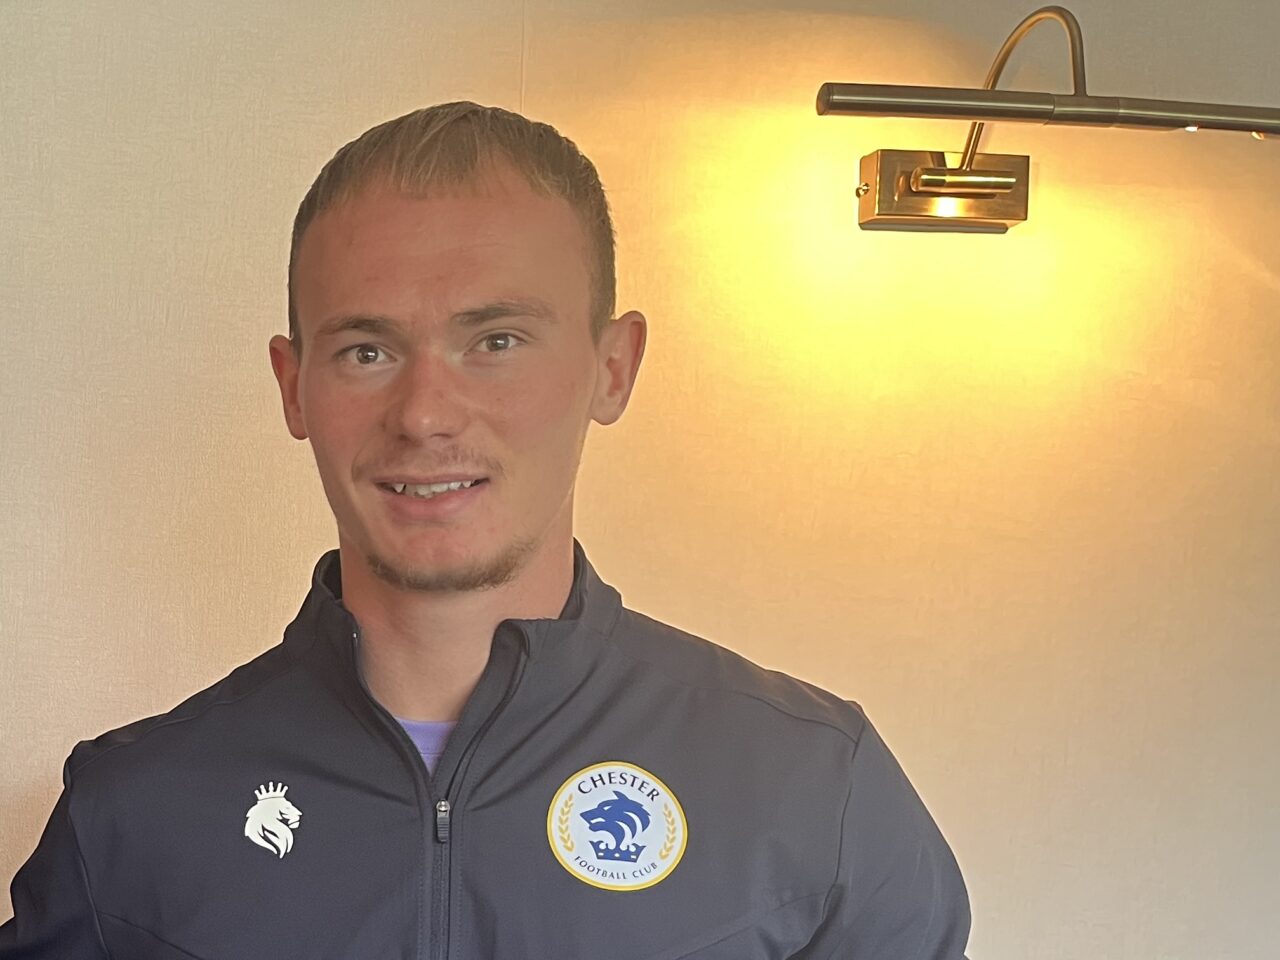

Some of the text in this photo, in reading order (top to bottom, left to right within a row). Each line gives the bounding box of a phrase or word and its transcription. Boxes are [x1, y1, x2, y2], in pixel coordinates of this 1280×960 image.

[577, 771, 660, 802] CHESTER
[574, 855, 659, 880] FOOTBALL CLUB
